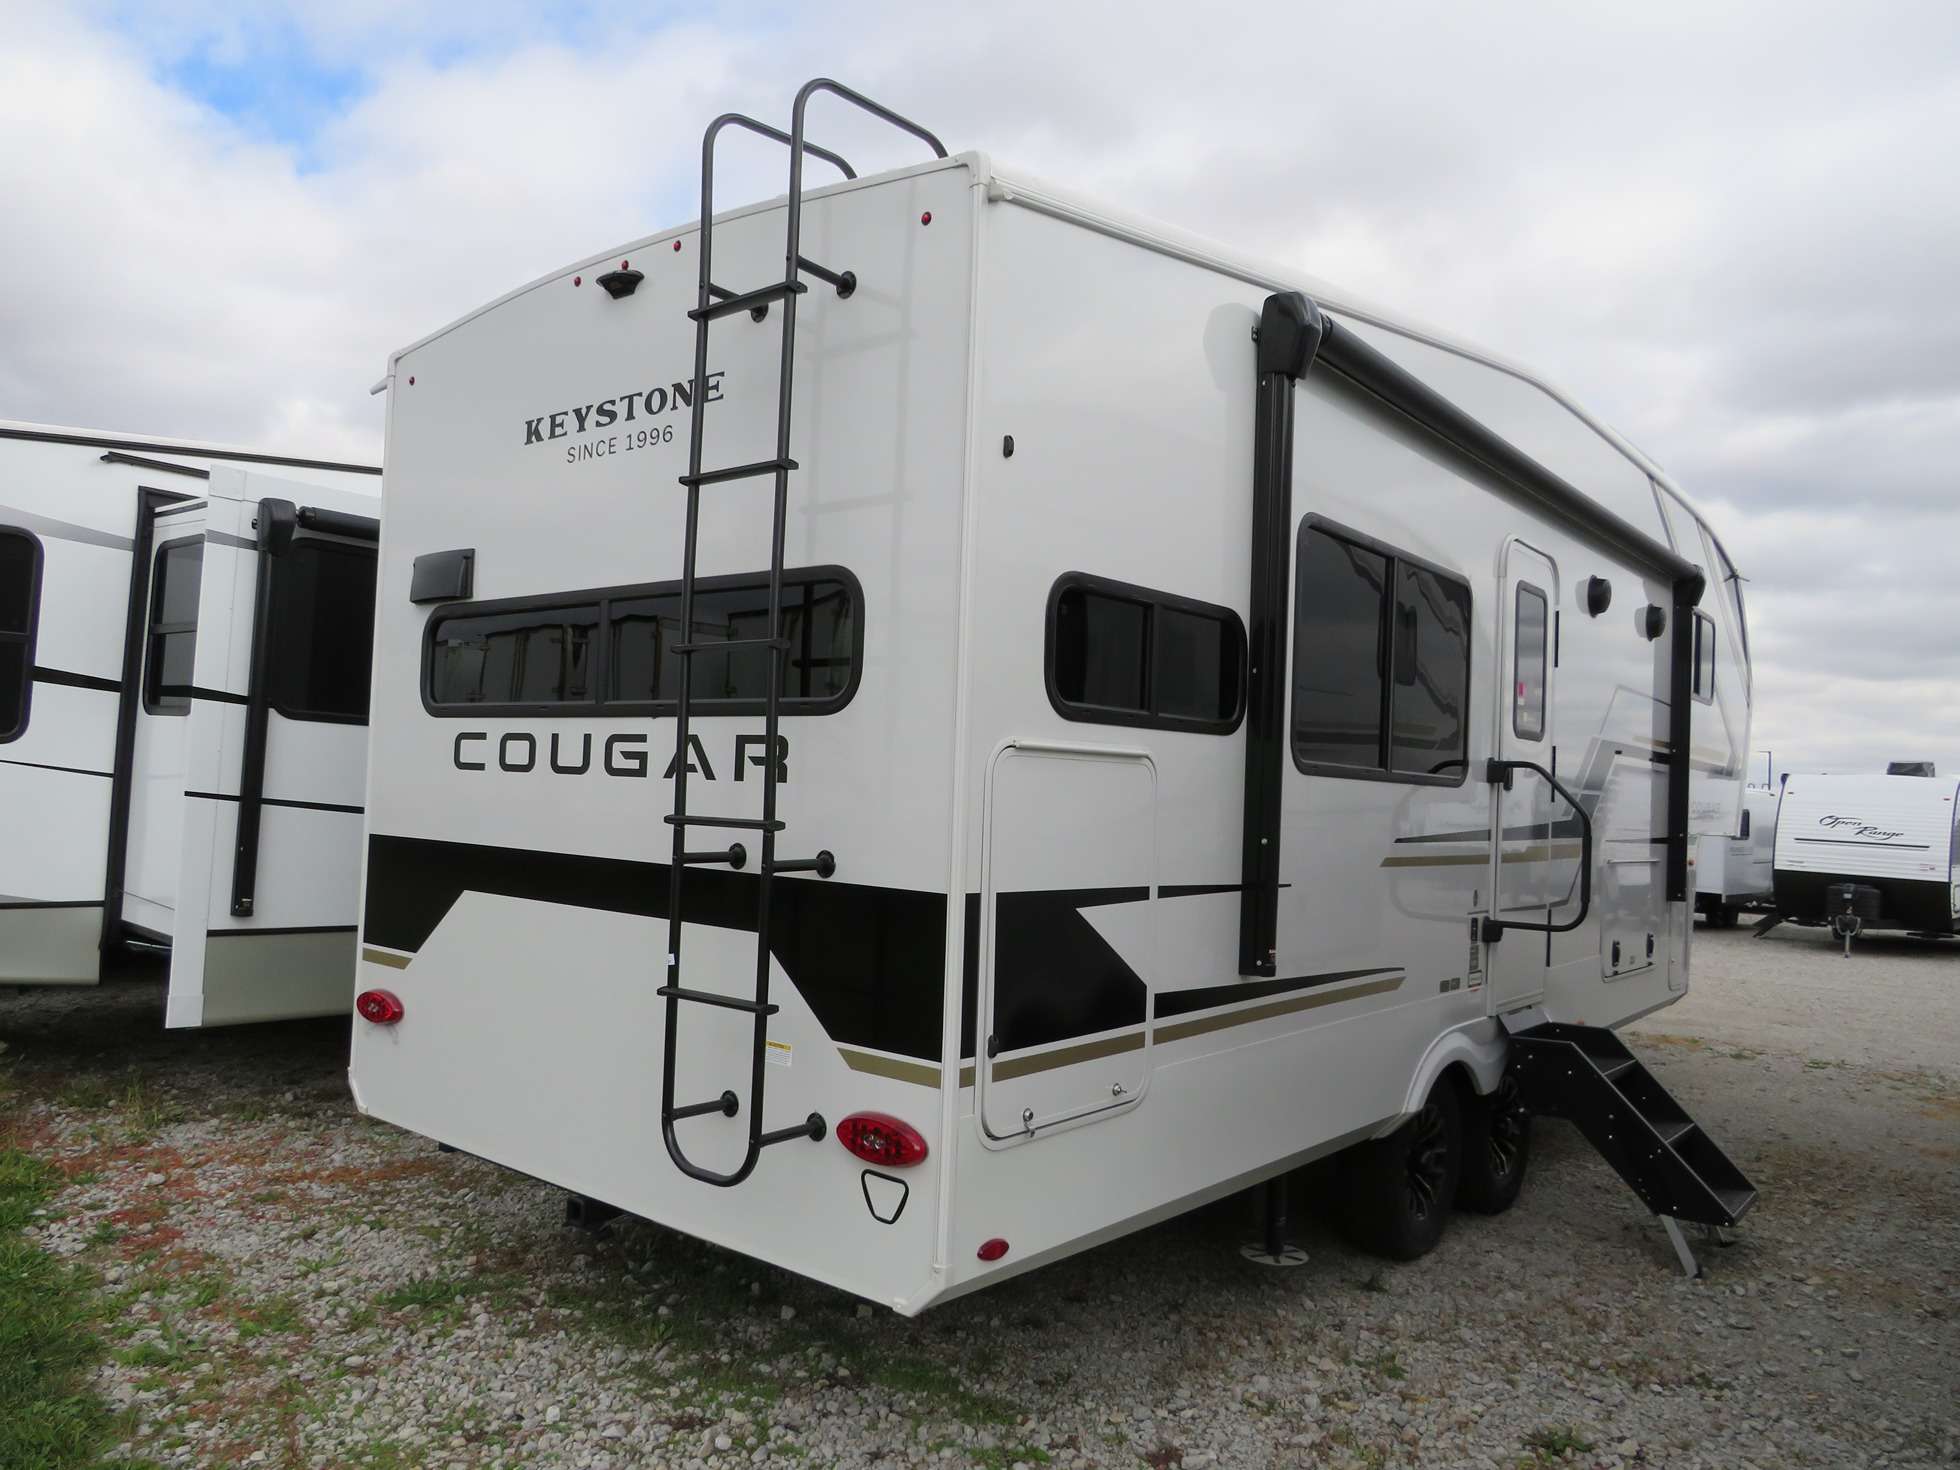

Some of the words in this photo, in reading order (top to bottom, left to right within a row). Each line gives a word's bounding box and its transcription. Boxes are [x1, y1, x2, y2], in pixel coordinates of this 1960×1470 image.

[524, 371, 725, 445] KEYSTONE
[567, 437, 617, 463] SINCE
[626, 425, 673, 451] 1996
[454, 732, 789, 783] COUGAR
[1819, 815, 1862, 828] Open
[1853, 827, 1904, 840] Range
